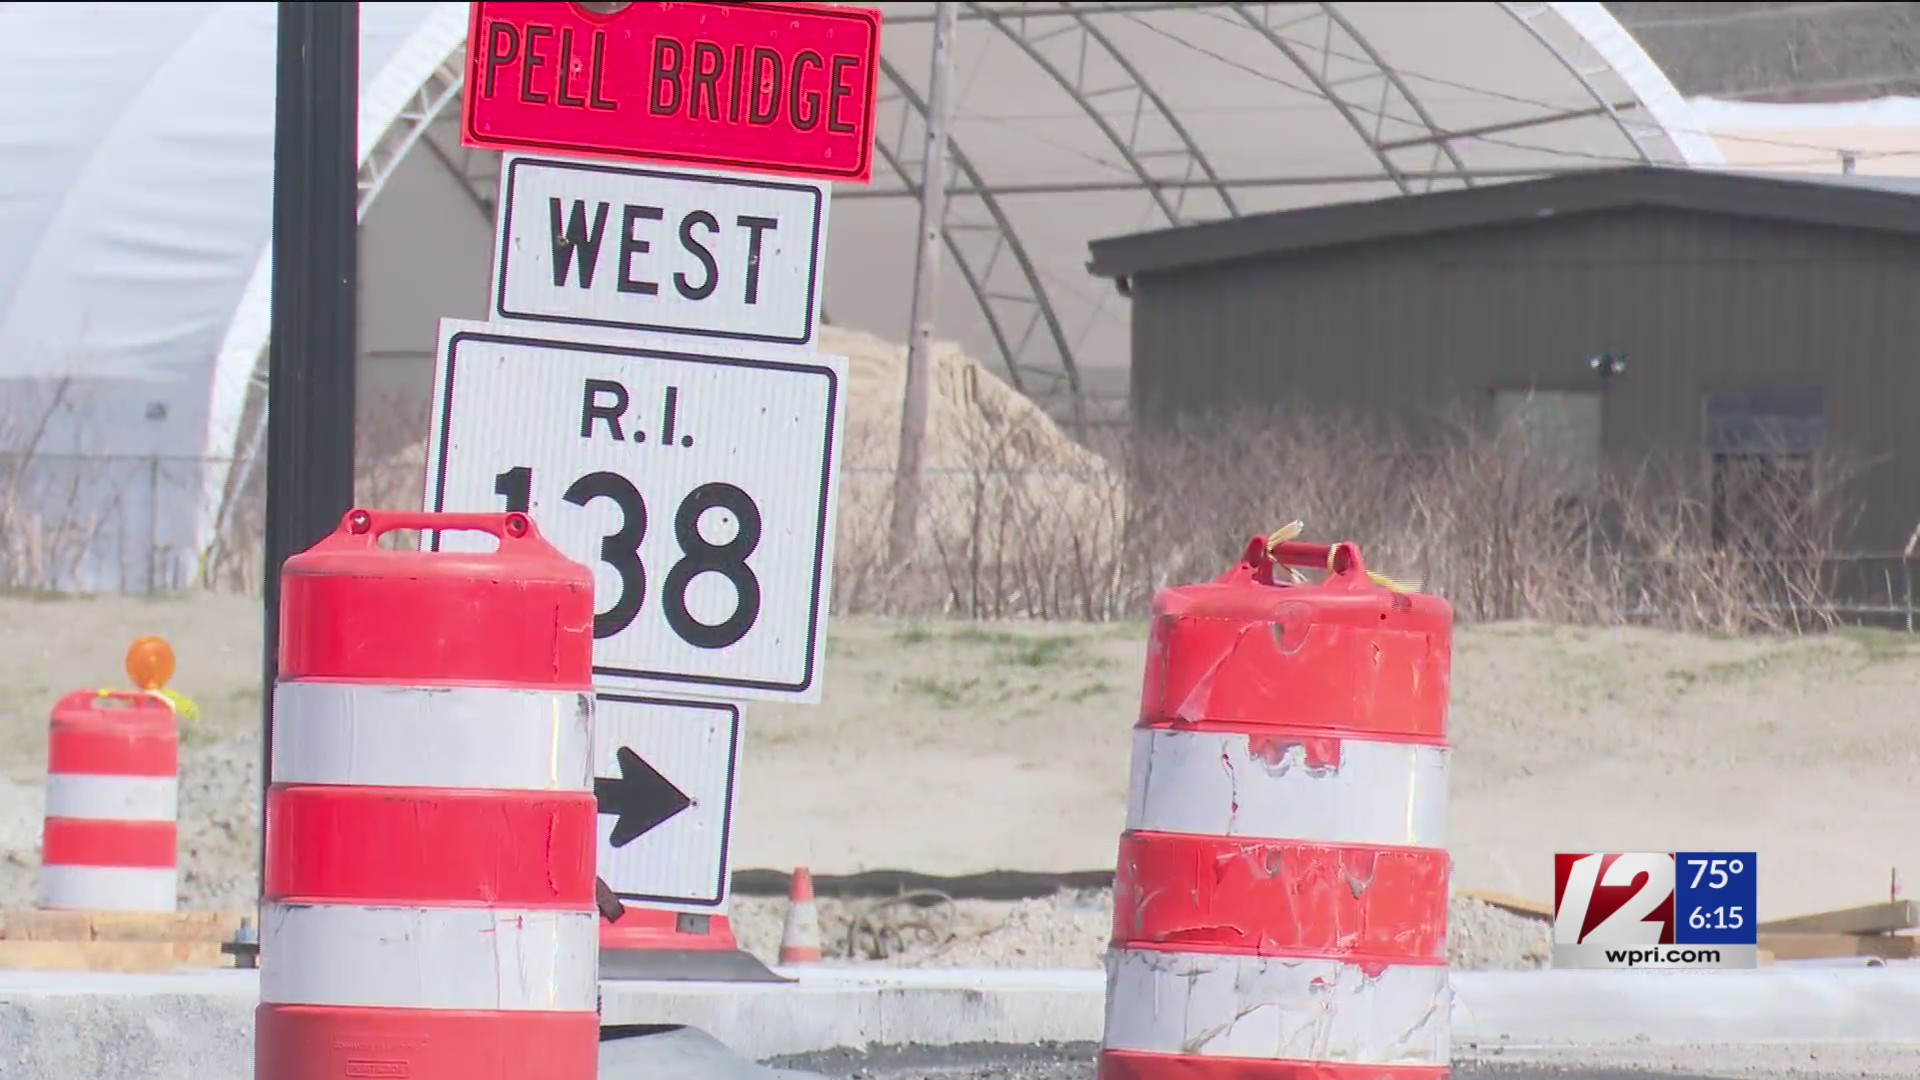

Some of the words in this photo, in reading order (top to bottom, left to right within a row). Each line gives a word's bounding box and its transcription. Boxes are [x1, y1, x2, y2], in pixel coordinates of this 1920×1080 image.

[484, 21, 617, 111] PELL
[650, 37, 860, 133] BRIDGE
[549, 197, 778, 304] WEST
[580, 378, 694, 448] R.I.
[495, 466, 762, 649] 38
